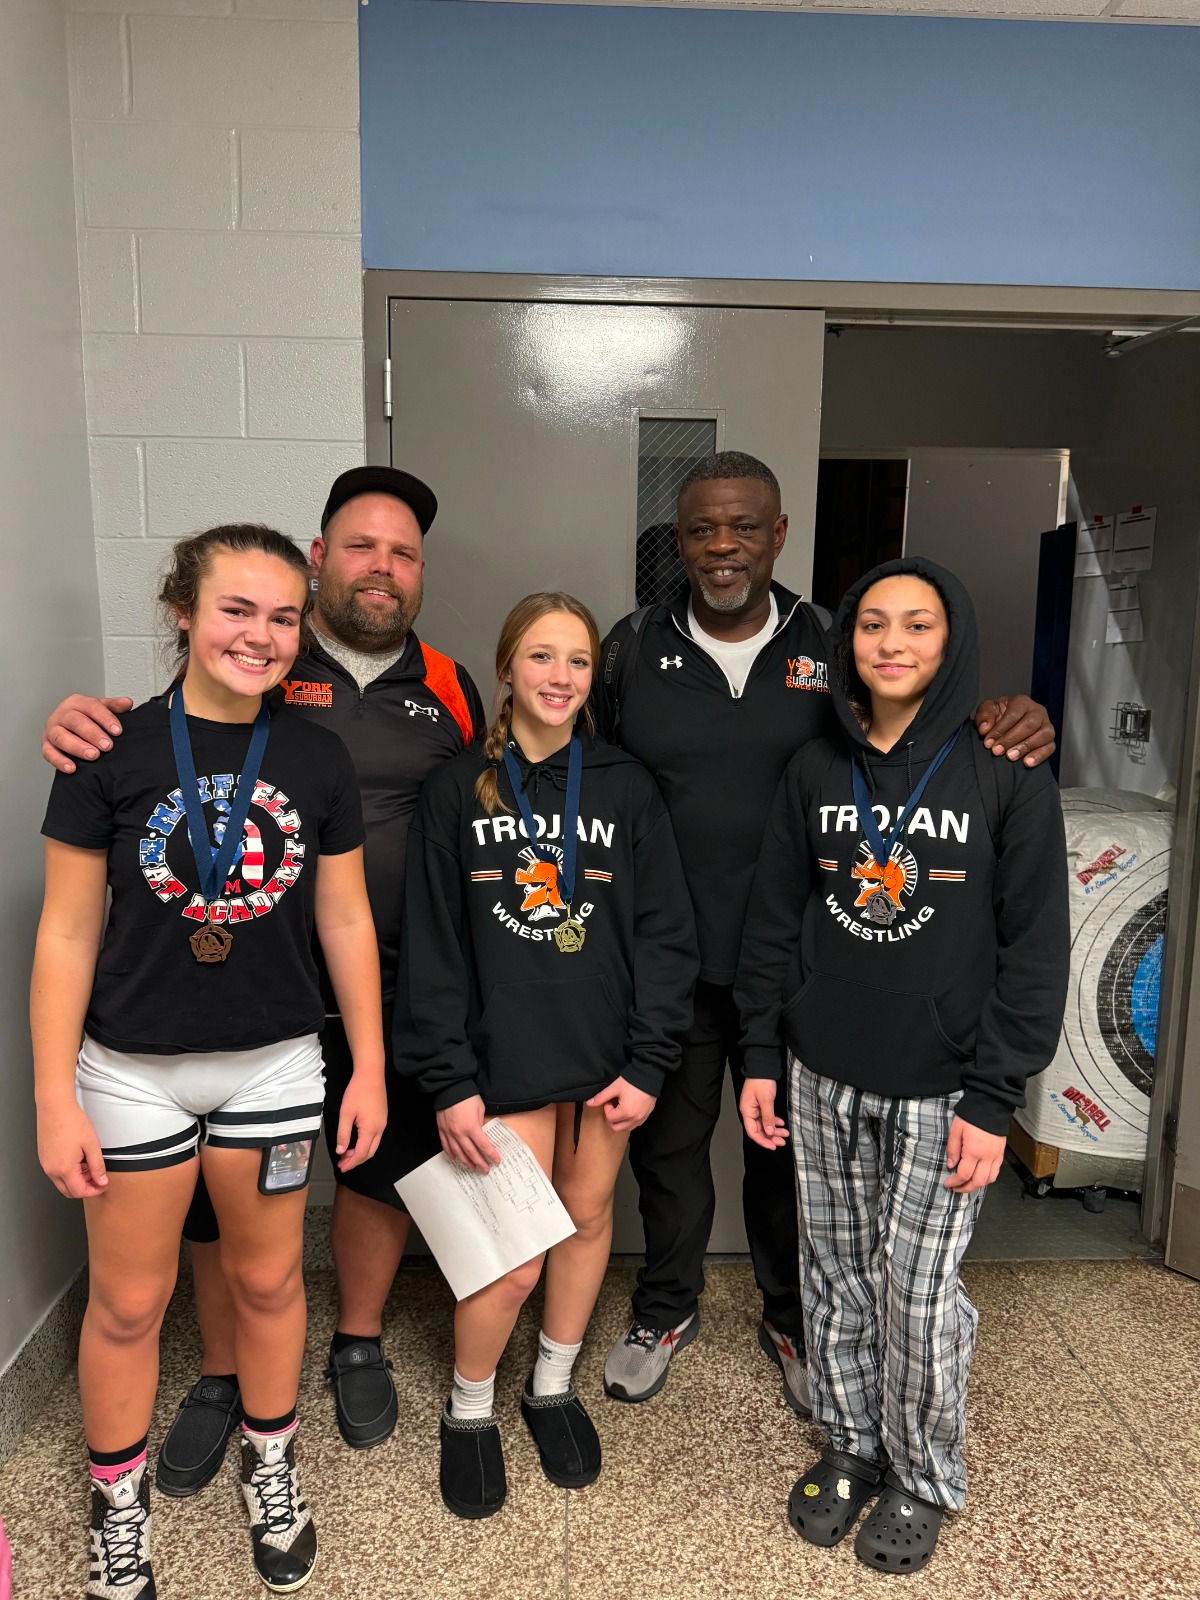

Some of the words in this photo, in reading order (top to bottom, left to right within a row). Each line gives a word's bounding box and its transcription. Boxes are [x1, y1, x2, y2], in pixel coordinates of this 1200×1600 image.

[279, 680, 333, 700] YORK
[294, 692, 333, 703] SUBURBAN
[139, 837, 188, 903] MAT
[181, 838, 306, 925] ACADEMY
[491, 901, 595, 942] WRESTNG
[825, 893, 936, 943] WRESTLING
